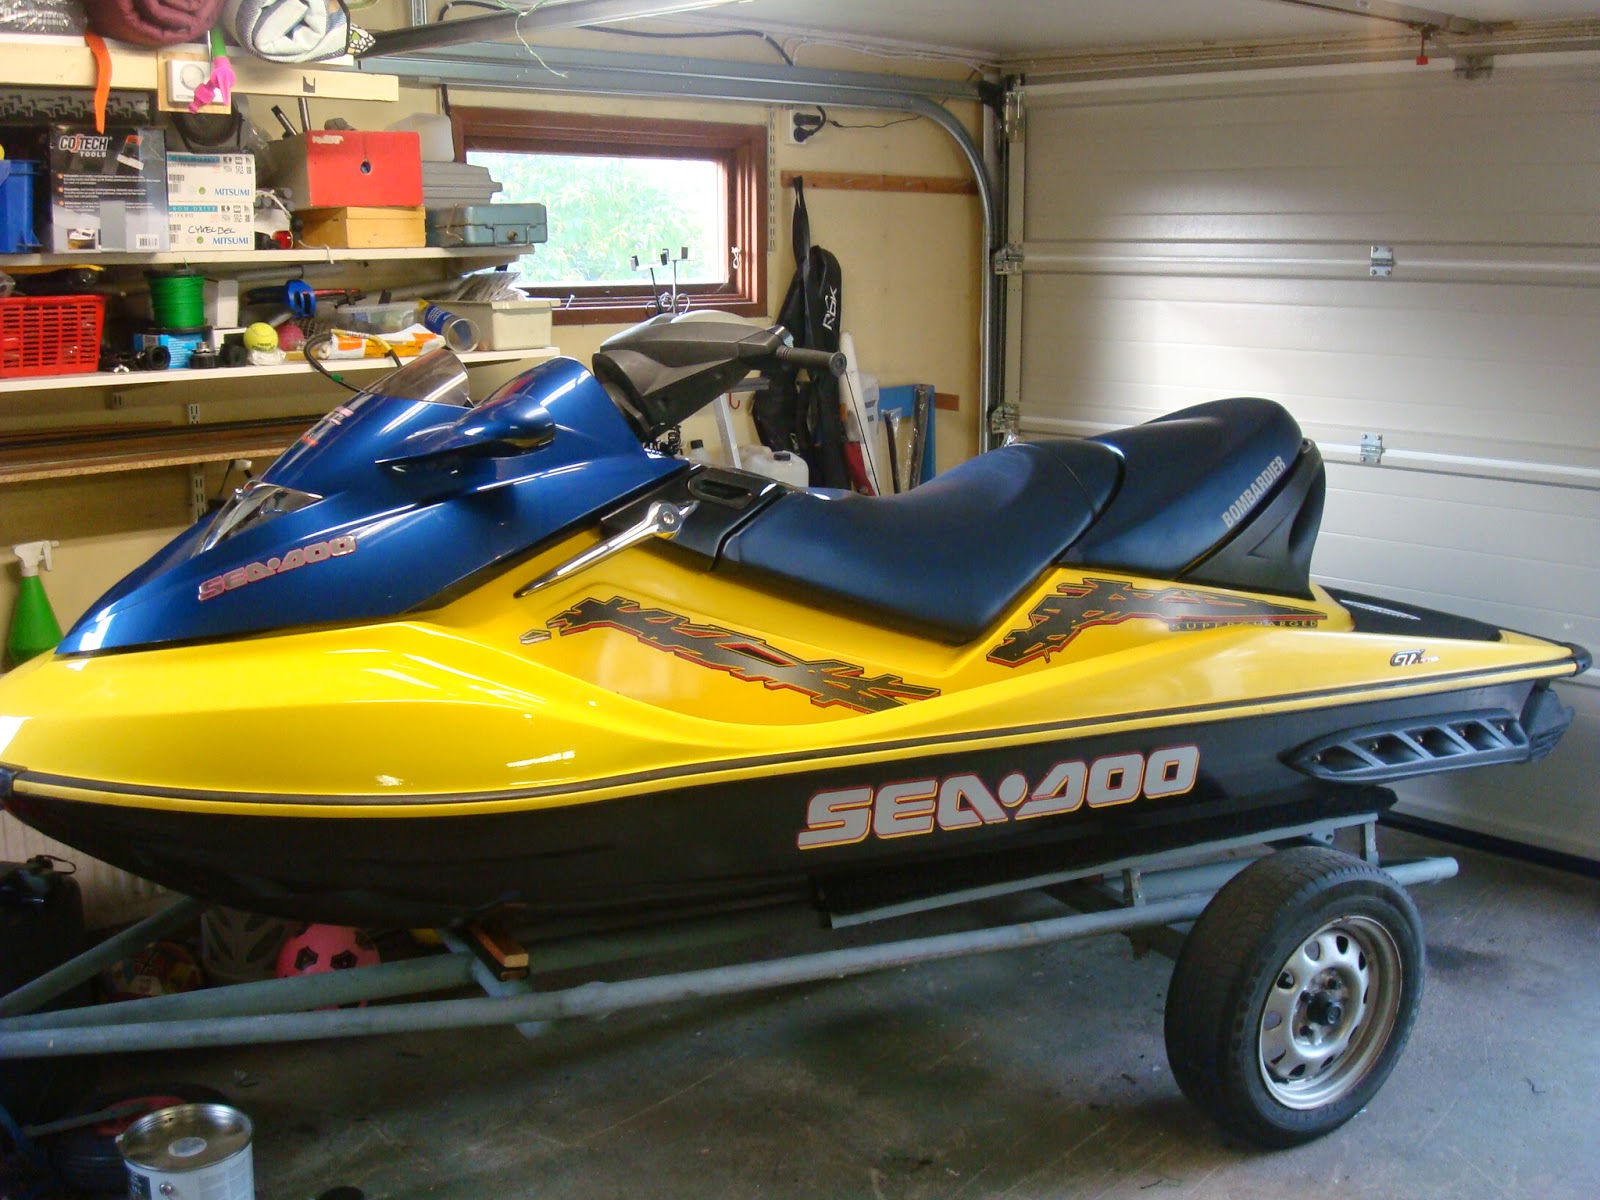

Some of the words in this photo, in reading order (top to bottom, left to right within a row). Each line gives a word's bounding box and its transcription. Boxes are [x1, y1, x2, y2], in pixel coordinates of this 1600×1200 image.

[214, 188, 250, 196] MITSUMI
[212, 236, 249, 245] MITSUMI
[1221, 455, 1287, 529] BOMBARDIER
